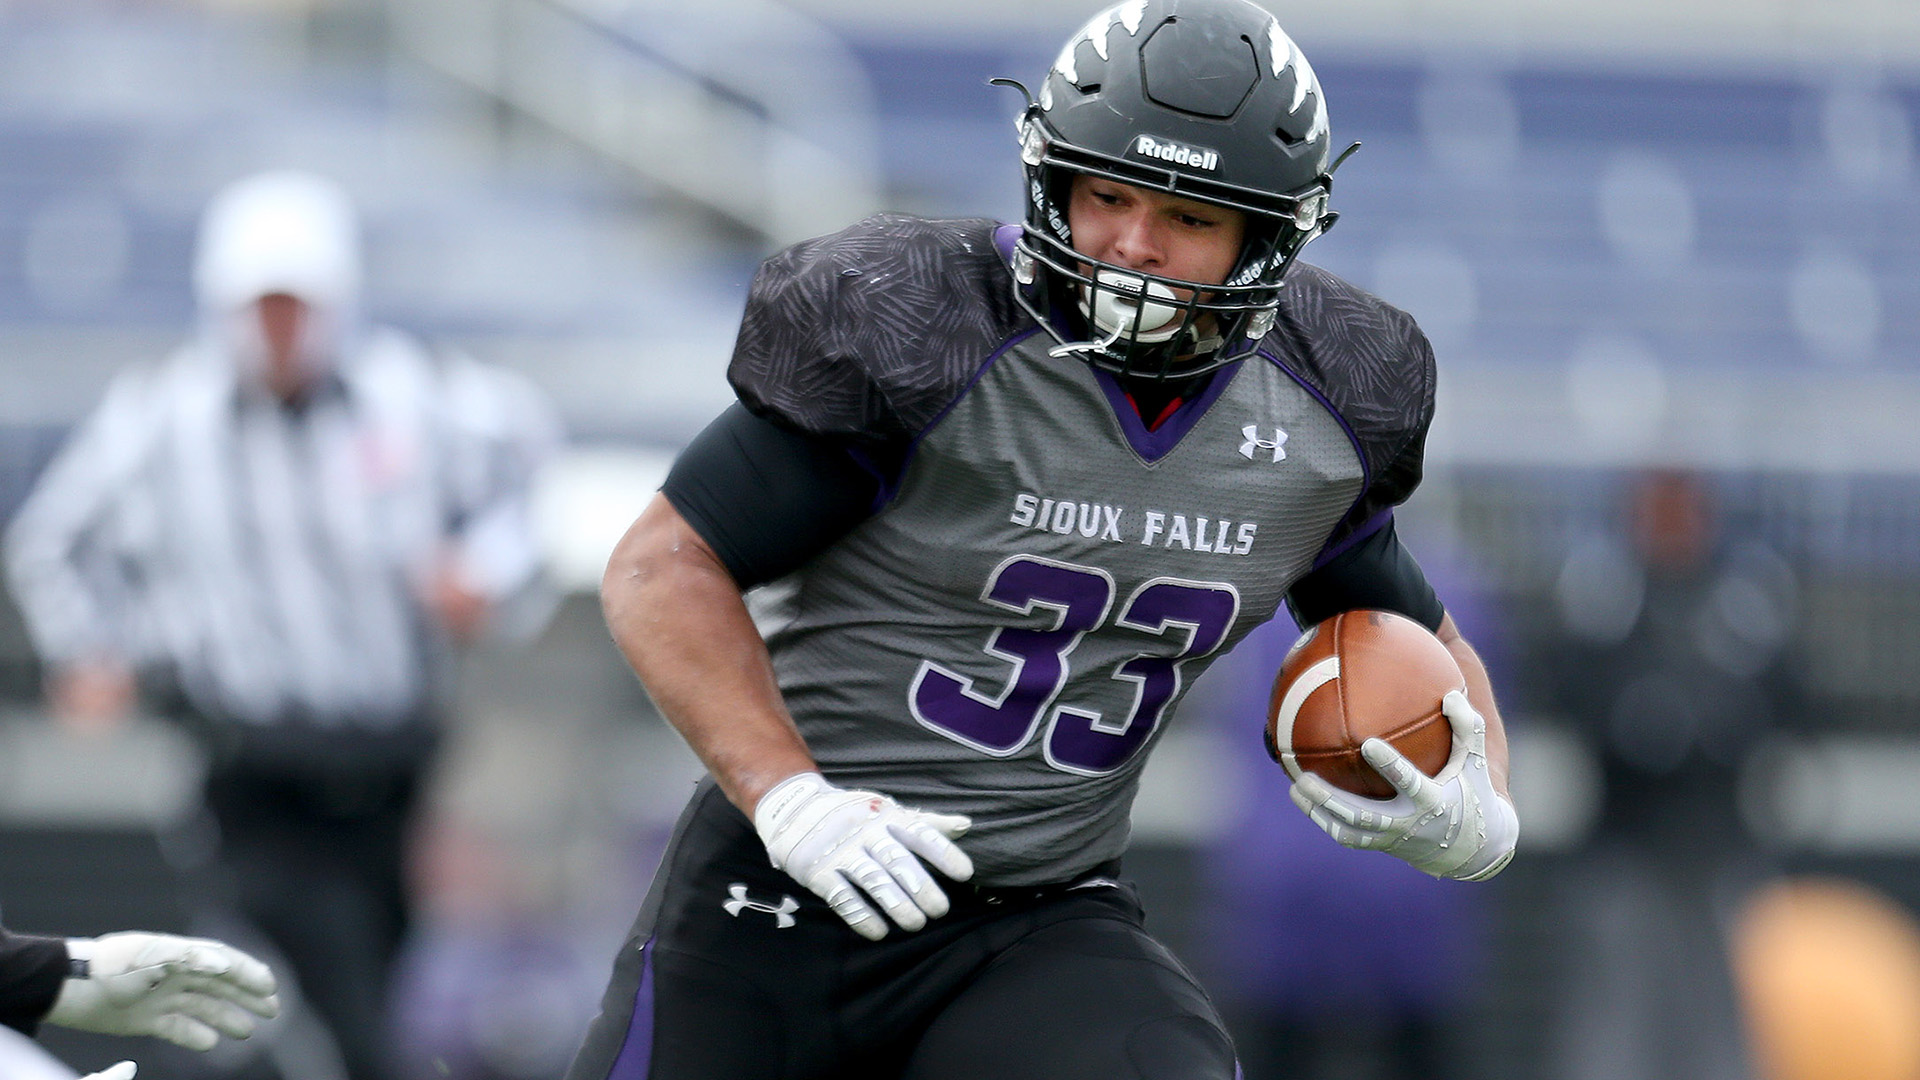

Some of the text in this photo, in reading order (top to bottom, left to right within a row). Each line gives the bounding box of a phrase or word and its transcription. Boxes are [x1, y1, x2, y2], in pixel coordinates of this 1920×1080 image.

[1137, 137, 1218, 171] Riddell
[1009, 493, 1257, 556] SIOUX FALLS
[908, 553, 1241, 778] 33
